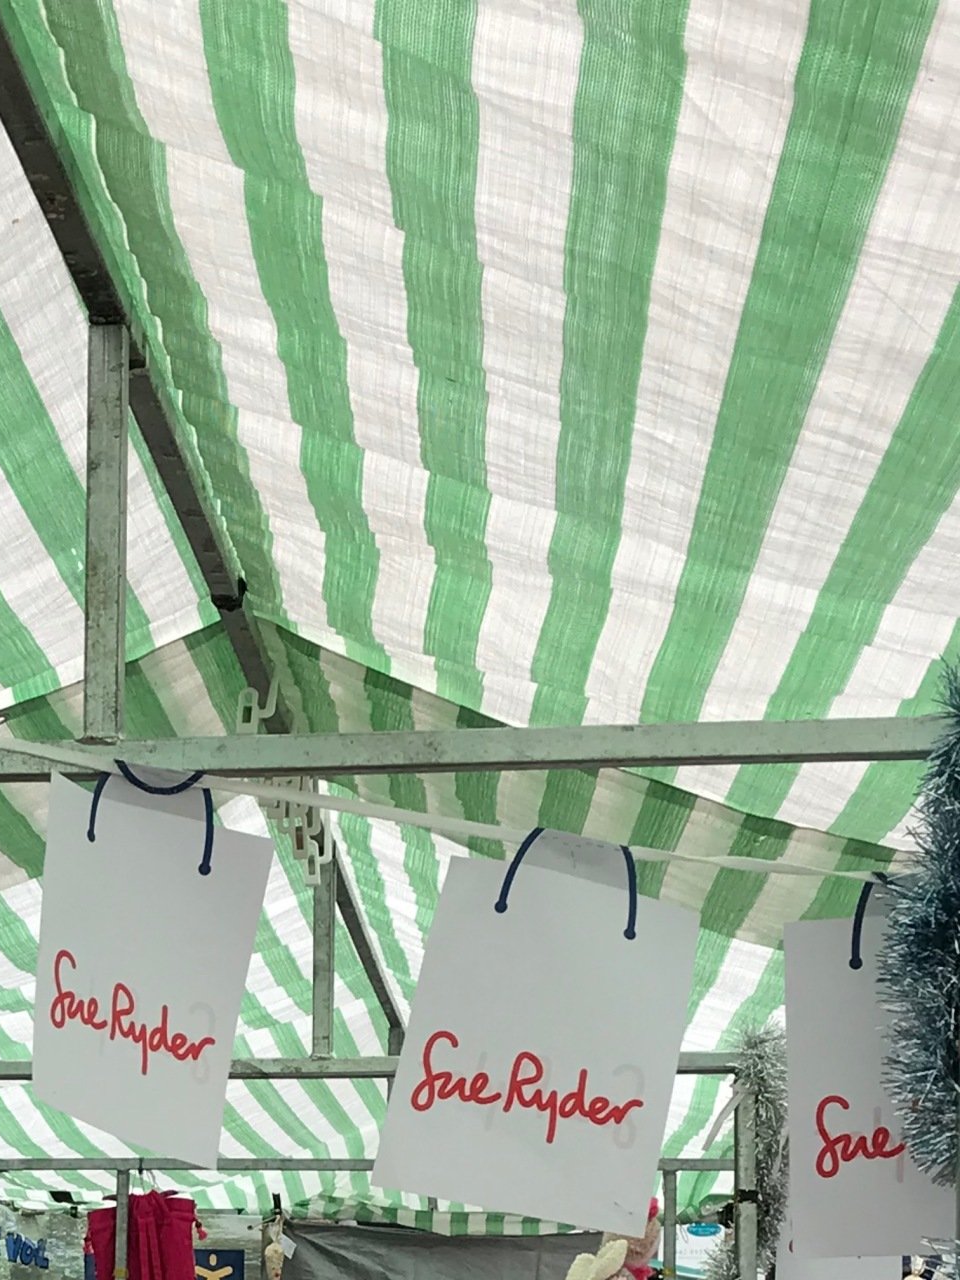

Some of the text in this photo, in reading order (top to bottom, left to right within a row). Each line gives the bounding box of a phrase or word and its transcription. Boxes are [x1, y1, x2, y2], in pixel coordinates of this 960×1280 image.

[50, 948, 216, 1076] Sue Ryder
[411, 1030, 644, 1144] Sue Ryder
[815, 1095, 907, 1178] Sue
